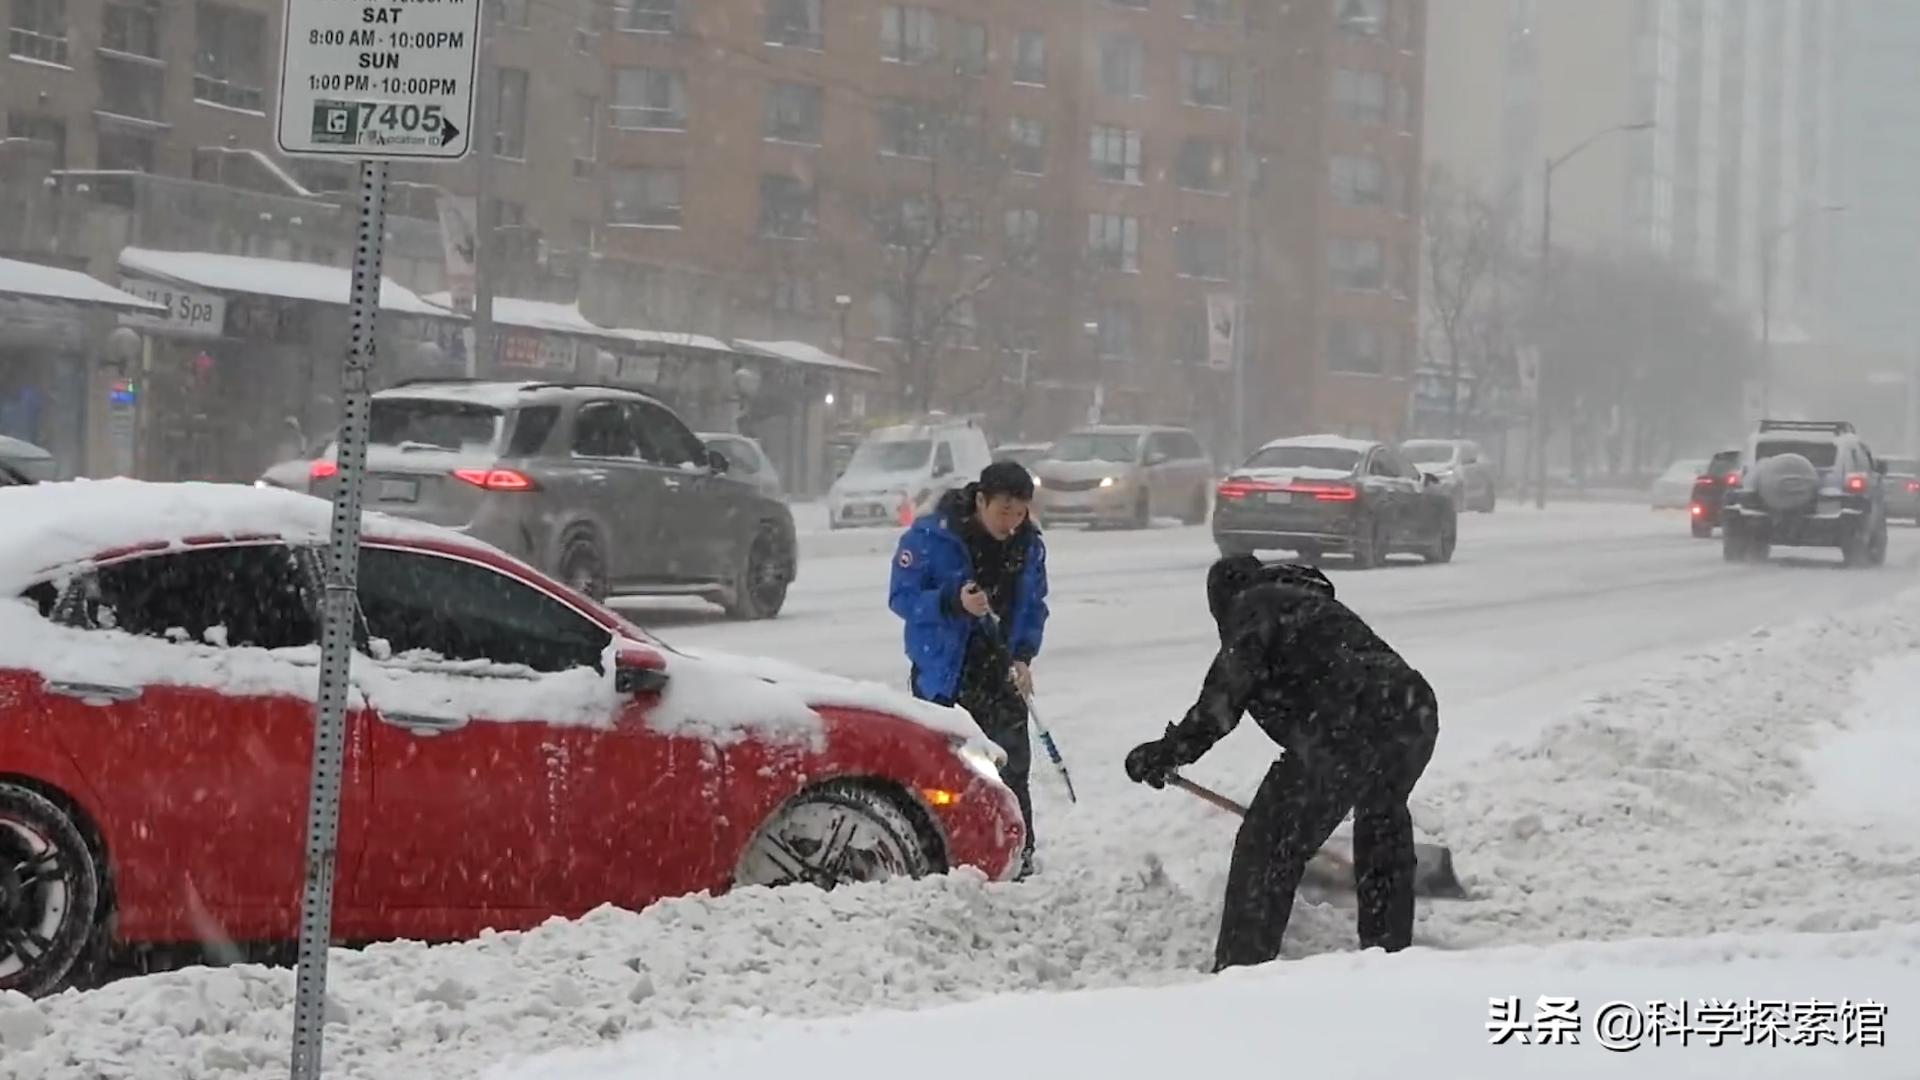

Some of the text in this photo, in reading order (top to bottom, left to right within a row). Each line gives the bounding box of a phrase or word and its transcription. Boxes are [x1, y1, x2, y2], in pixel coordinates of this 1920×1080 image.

[362, 8, 402, 24] SAT
[309, 29, 344, 45] 8:00
[349, 30, 375, 47] AM
[389, 31, 464, 48] 10:00PM
[358, 53, 399, 69] SUN
[309, 74, 340, 90] 1:00
[344, 75, 369, 91] PM
[382, 77, 456, 95] 10:00PM
[360, 102, 442, 132] 7405
[180, 295, 212, 327] Spa
